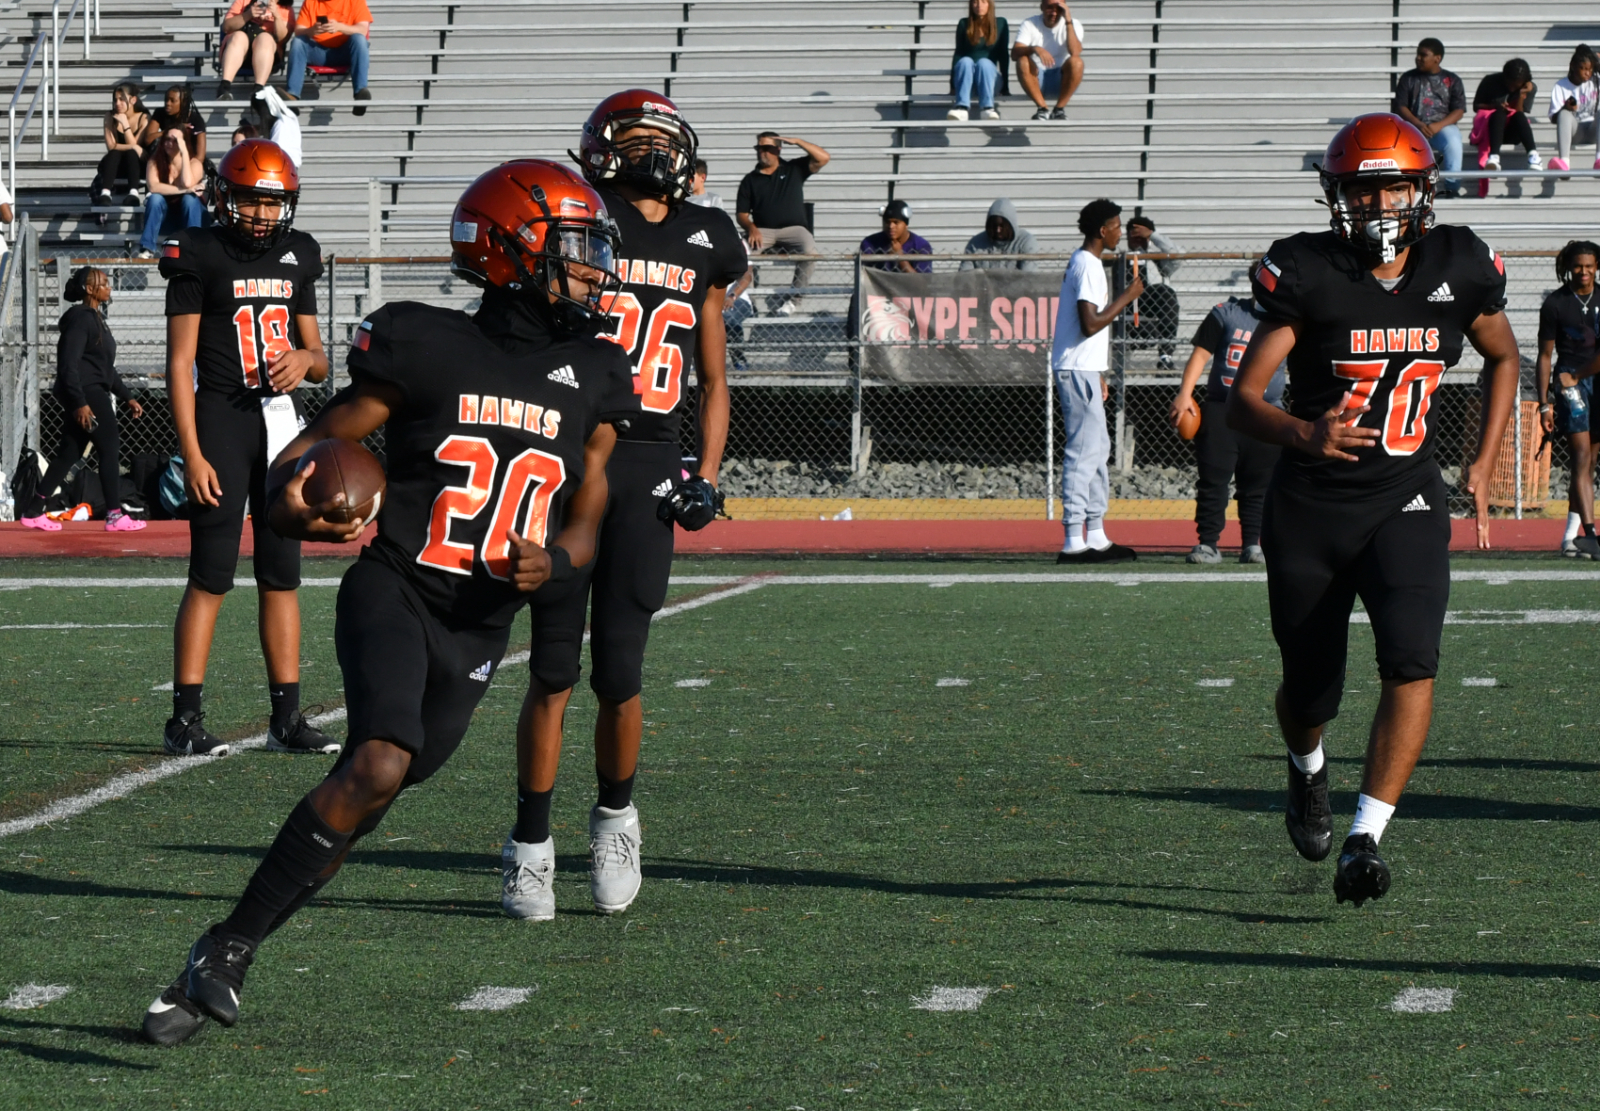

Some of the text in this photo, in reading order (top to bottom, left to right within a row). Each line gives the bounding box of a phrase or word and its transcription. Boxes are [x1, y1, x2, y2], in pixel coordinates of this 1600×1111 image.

[1363, 160, 1393, 169] Riddell
[687, 237, 714, 249] adidas
[613, 259, 697, 294] HAWKS
[233, 278, 293, 299] HAWKS
[1427, 294, 1454, 302] adidas
[1351, 328, 1440, 354] HAWKS
[547, 373, 580, 389] adidas
[458, 394, 562, 440] HAWKS
[1331, 358, 1447, 456] 70
[416, 434, 566, 582] 20
[1402, 504, 1431, 512] adidas
